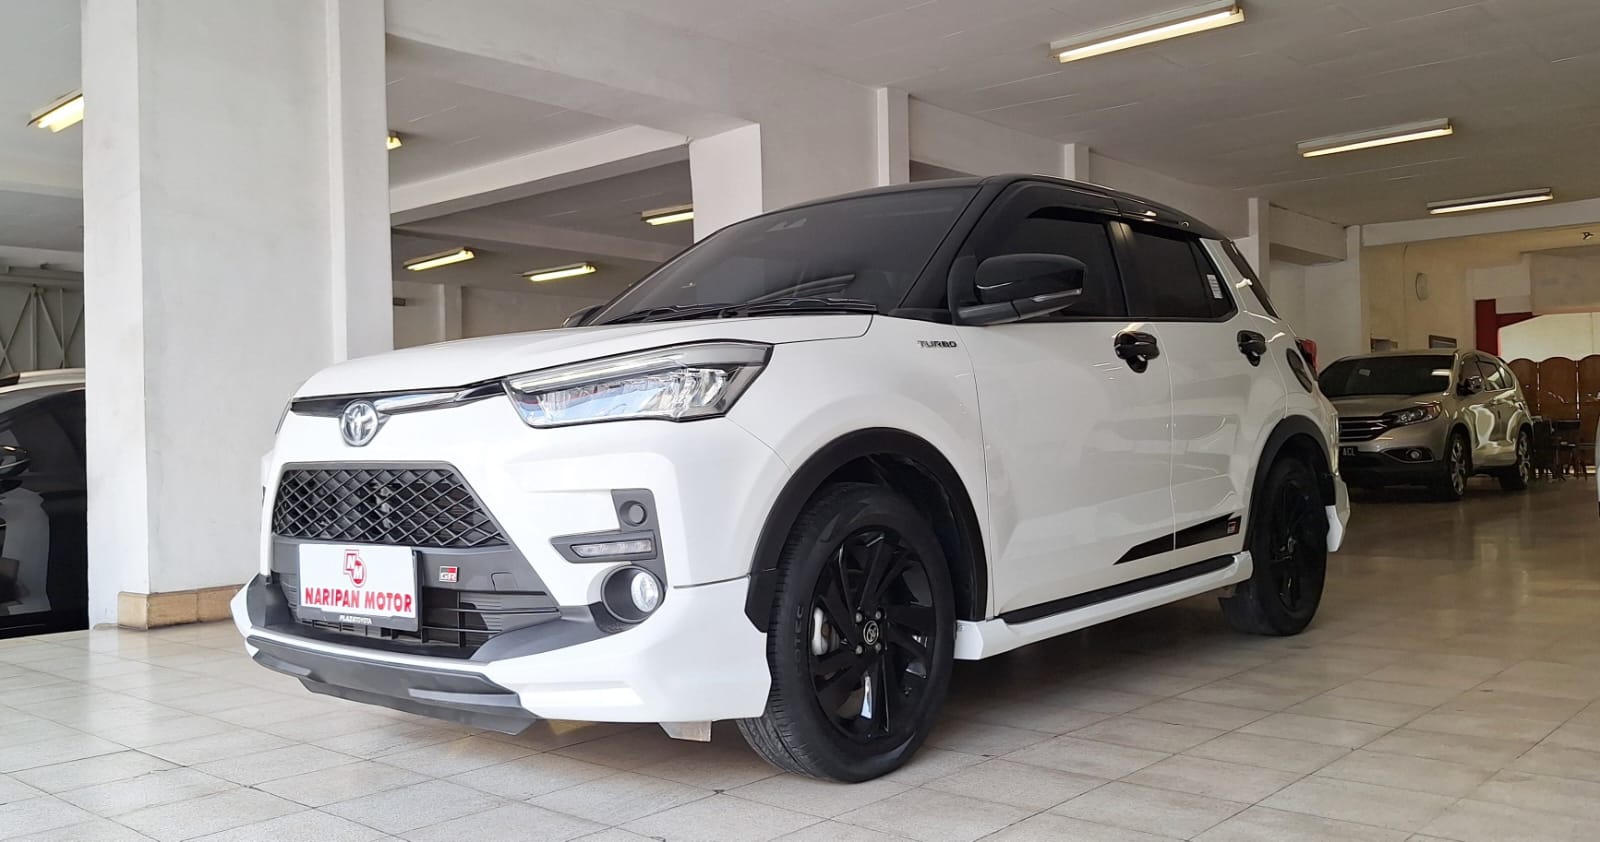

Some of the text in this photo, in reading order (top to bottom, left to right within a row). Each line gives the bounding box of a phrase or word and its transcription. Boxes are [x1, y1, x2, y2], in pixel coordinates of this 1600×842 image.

[917, 340, 957, 348] TURBO
[305, 586, 411, 613] NARIPAN MOTOR
